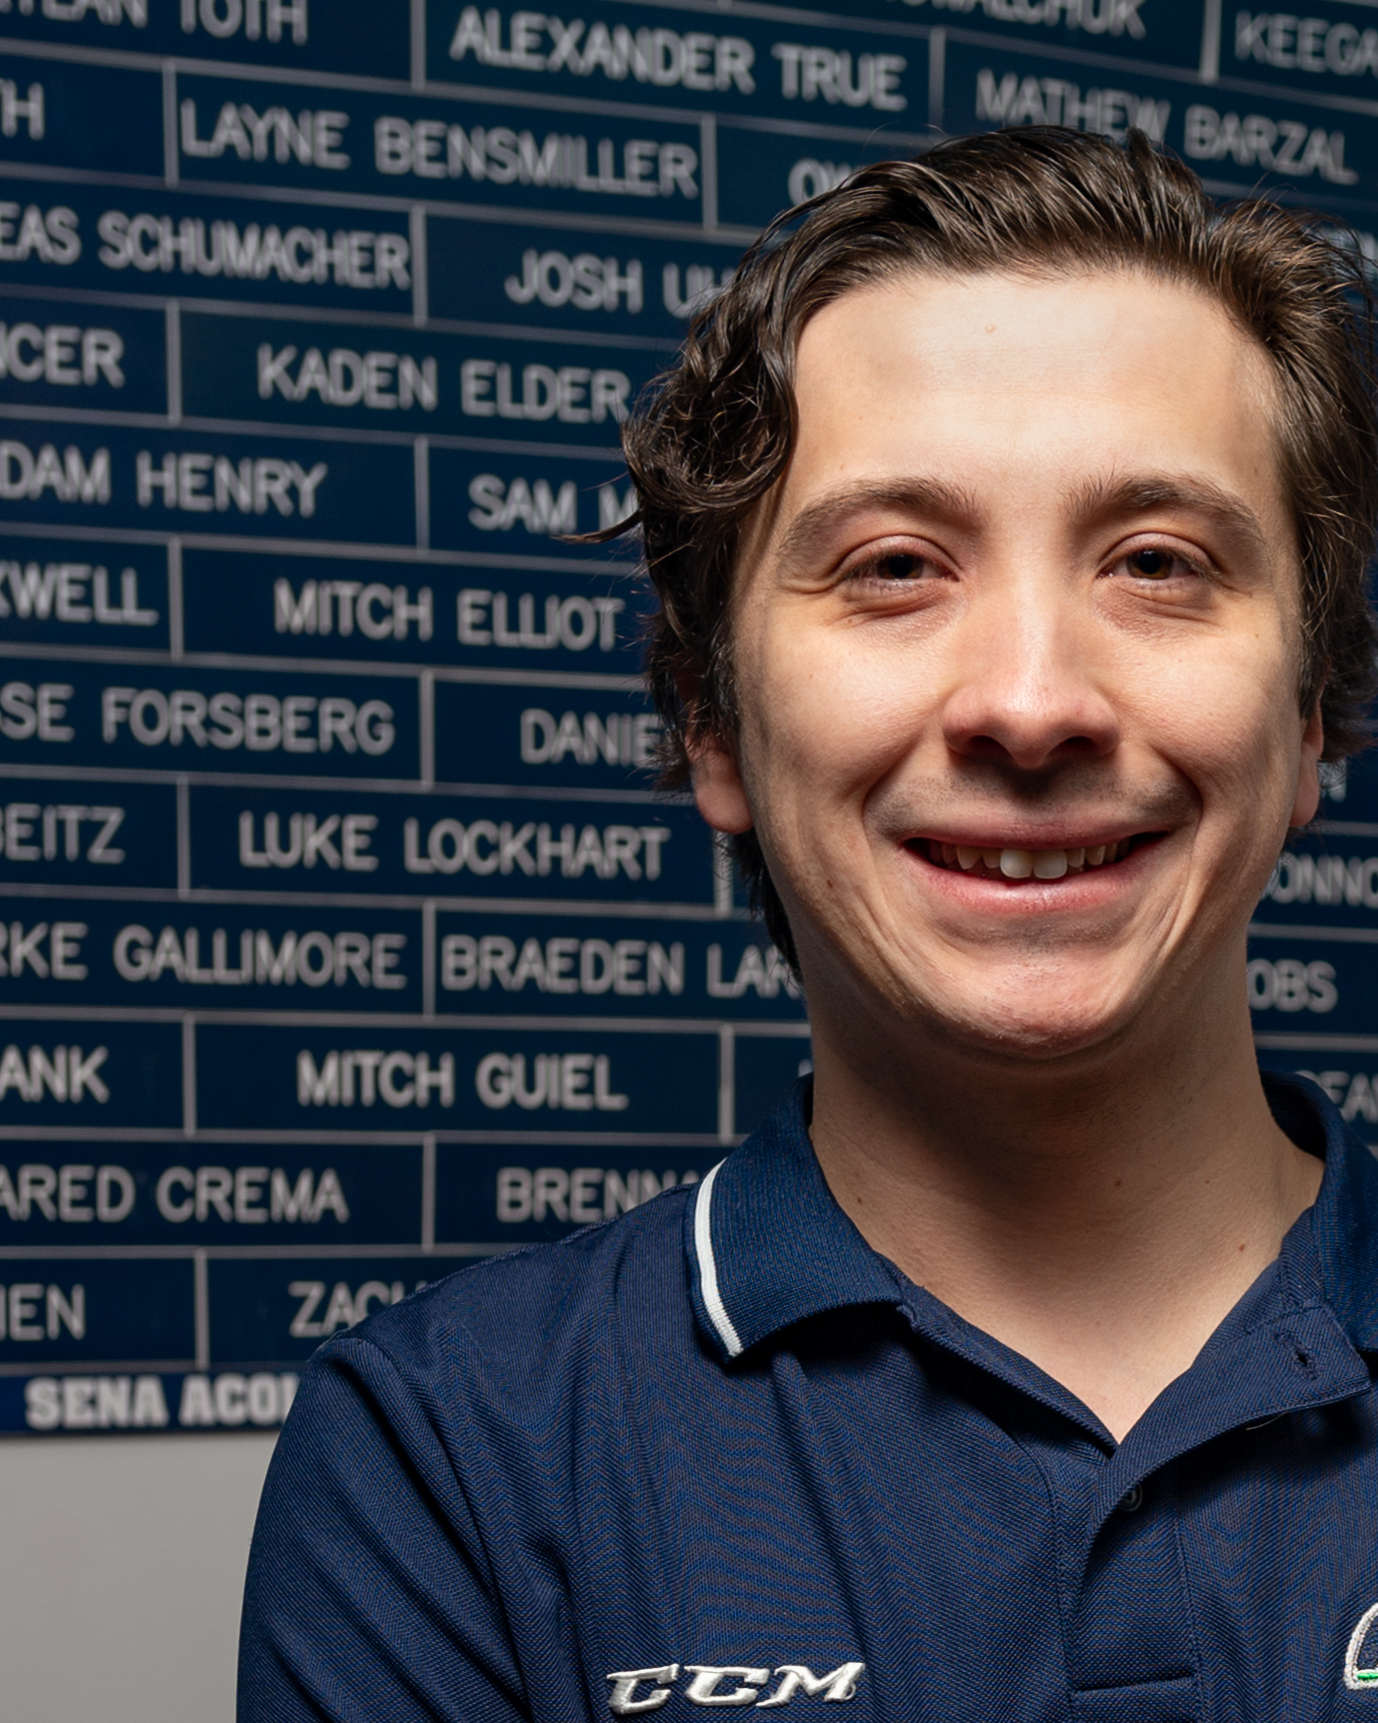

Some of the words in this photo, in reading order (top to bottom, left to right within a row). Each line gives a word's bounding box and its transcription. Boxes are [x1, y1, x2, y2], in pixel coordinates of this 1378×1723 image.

[449, 6, 755, 95] ALEXANDER
[772, 42, 908, 111] TRUE
[180, 99, 350, 169] LAYNE
[374, 116, 699, 199] BENSMILLER
[975, 67, 1171, 147] MATHEW
[1184, 103, 1359, 185] BARZAL
[98, 210, 412, 291] SCHUMACHER
[504, 248, 643, 314] JOSH
[0, 322, 125, 388] CER
[257, 342, 438, 411] KADEN
[461, 359, 632, 423] ELDER
[136, 450, 328, 517] HENRY
[468, 475, 578, 533] SAM
[0, 560, 160, 626] WELL
[273, 577, 433, 640] MITCH
[457, 590, 626, 652] ELLIOT
[102, 686, 395, 755] FORSBERG
[0, 803, 126, 864] EITZ
[239, 811, 379, 872] LUKE
[404, 818, 671, 881] LOCKHART
[113, 925, 406, 989] GALLIMORE
[441, 934, 684, 995] BRAEDEN
[297, 1049, 454, 1108] MITCH
[476, 1053, 628, 1111] GUIEL
[155, 1165, 348, 1223] CREMA
[24, 1376, 169, 1430] SENA
[606, 1661, 866, 1714] CCM
